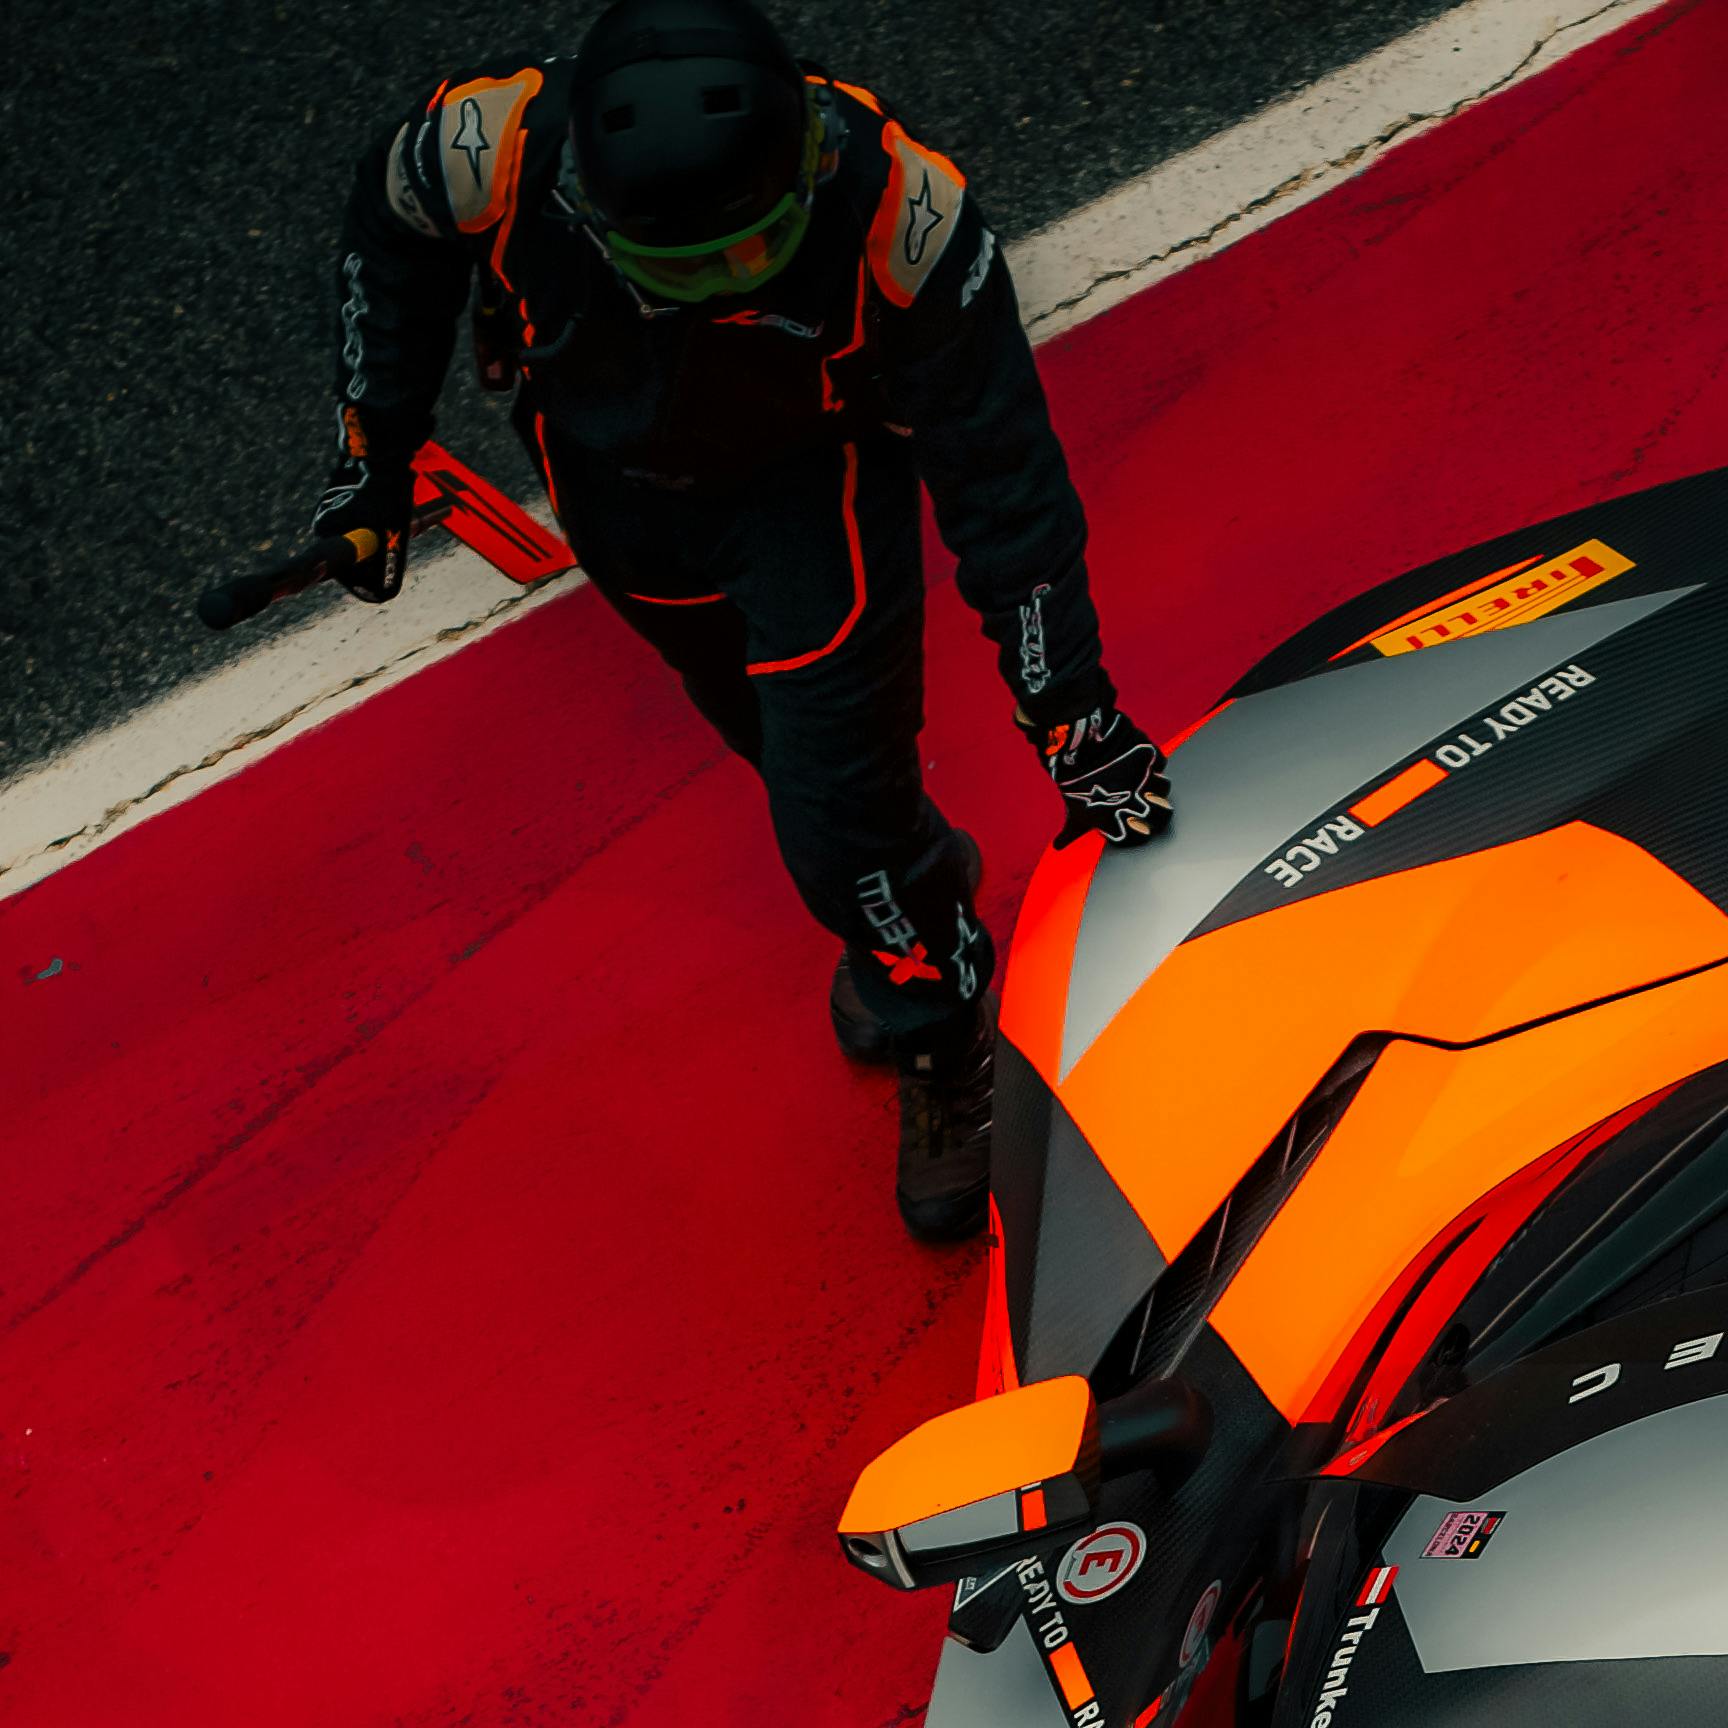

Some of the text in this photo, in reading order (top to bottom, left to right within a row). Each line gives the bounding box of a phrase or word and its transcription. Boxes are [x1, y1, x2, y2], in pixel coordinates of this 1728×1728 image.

[1405, 555, 1606, 650] PIRELLI
[1435, 663, 1598, 770] READY TO
[1265, 814, 1366, 888] RACE
[1443, 1512, 1481, 1556] 2024
[1038, 1610, 1070, 1649] TO
